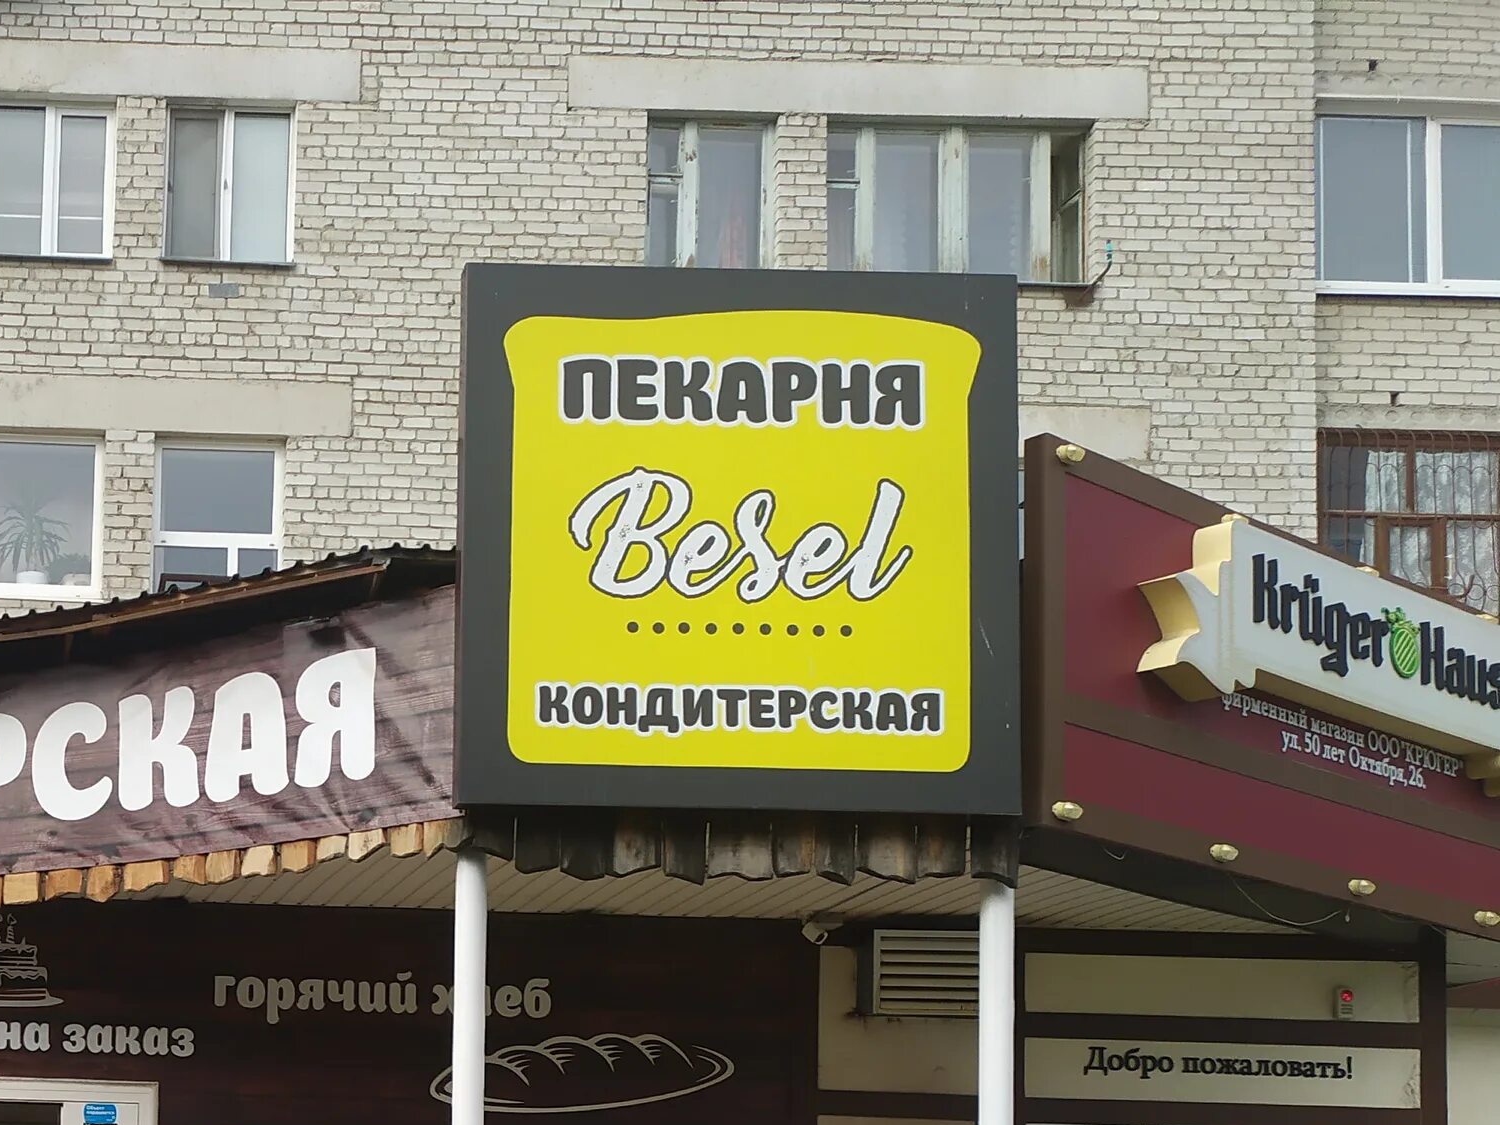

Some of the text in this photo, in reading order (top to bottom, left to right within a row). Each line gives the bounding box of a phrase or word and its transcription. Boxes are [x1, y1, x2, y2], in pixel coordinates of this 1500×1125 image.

[560, 357, 924, 429] ПЕКАРНЯ
[569, 466, 912, 603] Besel
[1252, 553, 1389, 677] Krüger
[537, 685, 942, 734] КОНДИТЕРСКАЯ
[1310, 717, 1365, 748] магазин
[1281, 730, 1427, 790] ул. 50 лет Октября, 26.
[214, 971, 418, 1023] горячий
[62, 1022, 196, 1057] заказ
[1083, 1046, 1353, 1080] Добро пожаловать!
